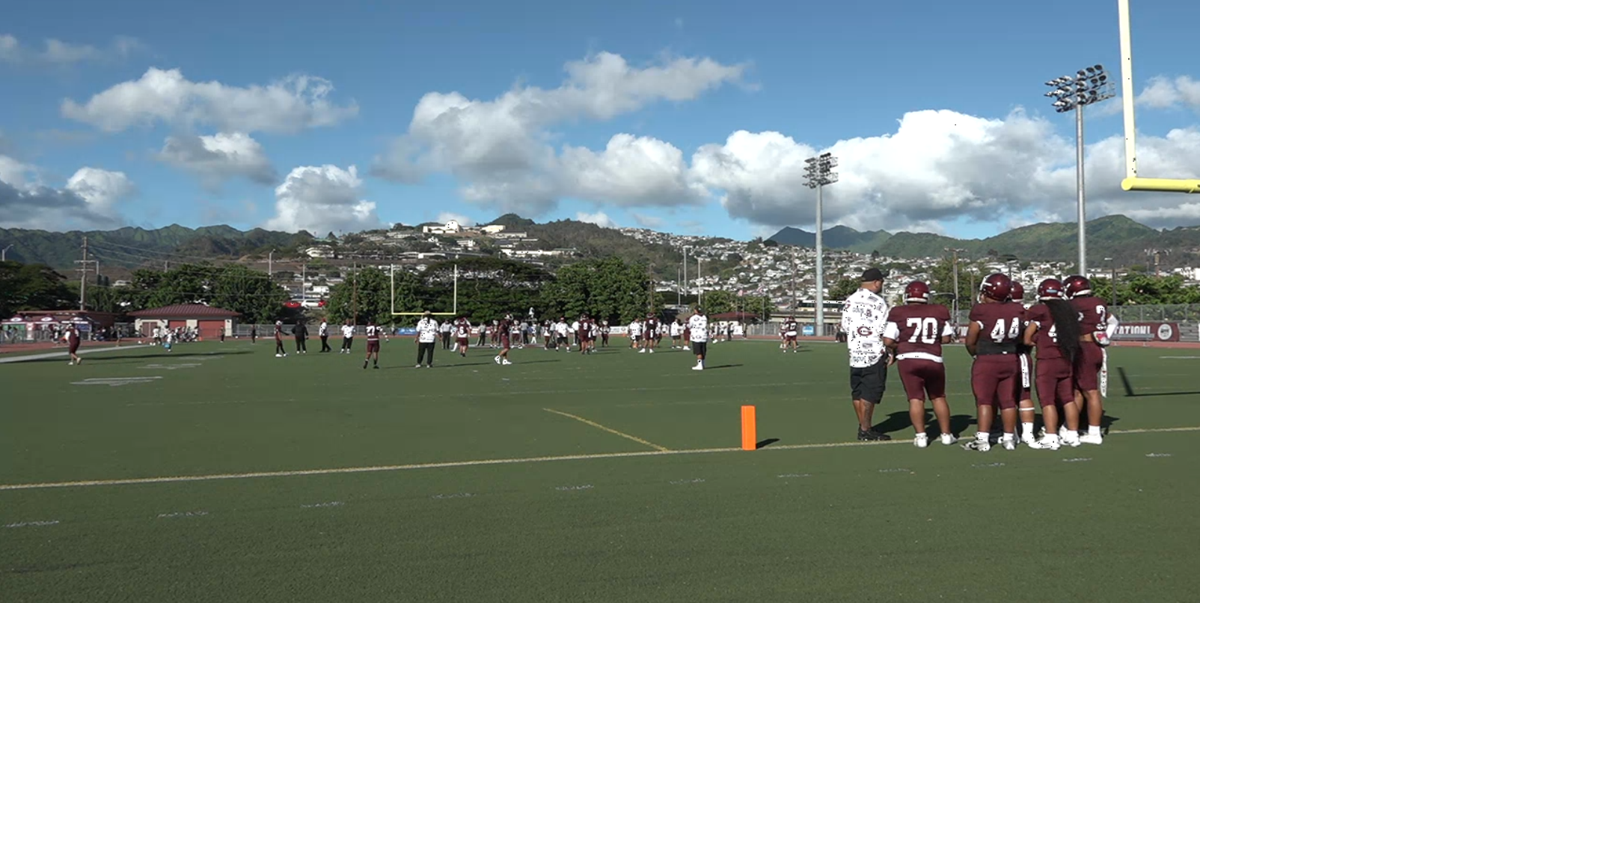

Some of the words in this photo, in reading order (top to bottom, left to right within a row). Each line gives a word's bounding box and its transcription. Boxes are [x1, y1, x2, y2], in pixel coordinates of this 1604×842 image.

[857, 325, 873, 337] G
[906, 317, 938, 344] 70
[990, 317, 1020, 343] 44
